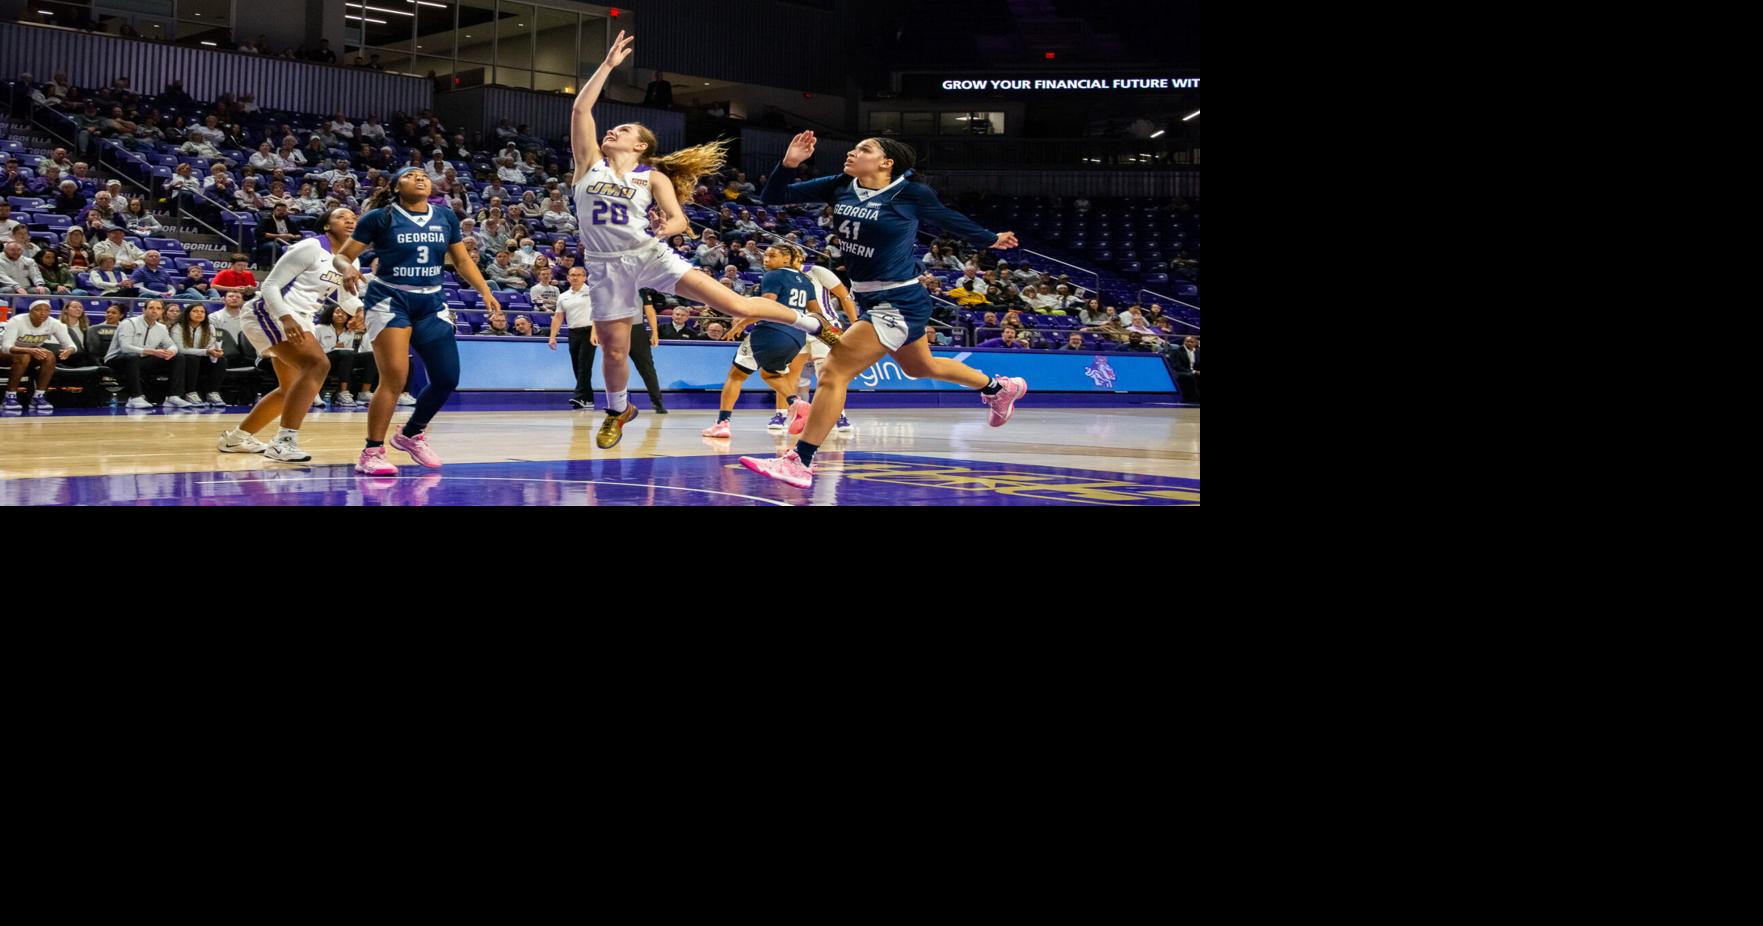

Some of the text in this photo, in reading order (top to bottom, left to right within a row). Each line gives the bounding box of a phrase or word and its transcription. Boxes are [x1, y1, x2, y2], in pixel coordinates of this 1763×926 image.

[942, 80, 987, 90] GROW
[990, 80, 1031, 90] YOUR
[1034, 80, 1110, 89] FINANCIAL
[1112, 79, 1168, 89] FUTURE
[592, 200, 629, 226] 20
[833, 203, 881, 222] GEORGIA
[397, 232, 446, 244] GEORGIA
[838, 219, 861, 241] 41
[416, 245, 430, 264] 3
[839, 239, 875, 259] THERN
[788, 287, 807, 308] 20
